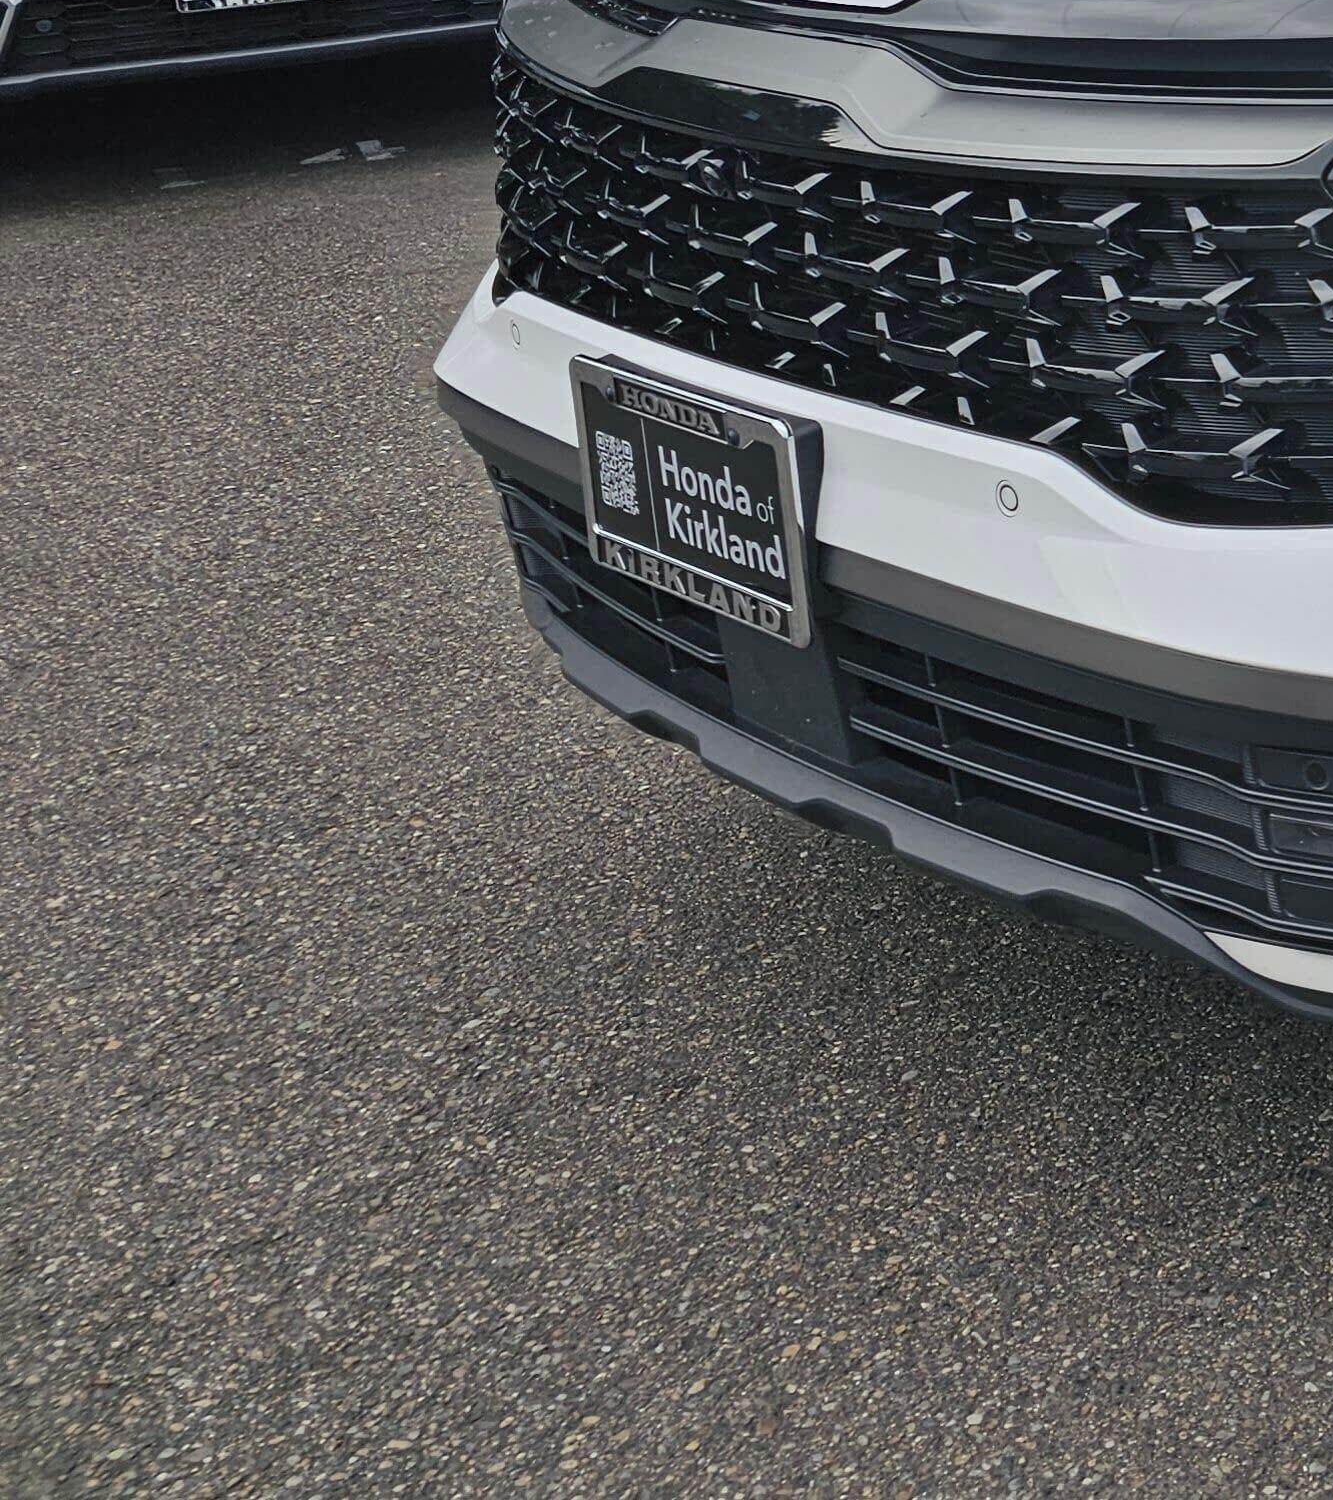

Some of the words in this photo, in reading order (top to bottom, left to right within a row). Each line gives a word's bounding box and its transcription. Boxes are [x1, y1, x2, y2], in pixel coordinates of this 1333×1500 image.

[620, 384, 720, 435] HONDA
[657, 444, 752, 517] Honda
[756, 496, 774, 524] of
[664, 498, 786, 579] Kirkland
[604, 539, 782, 633] KIRKLAND
